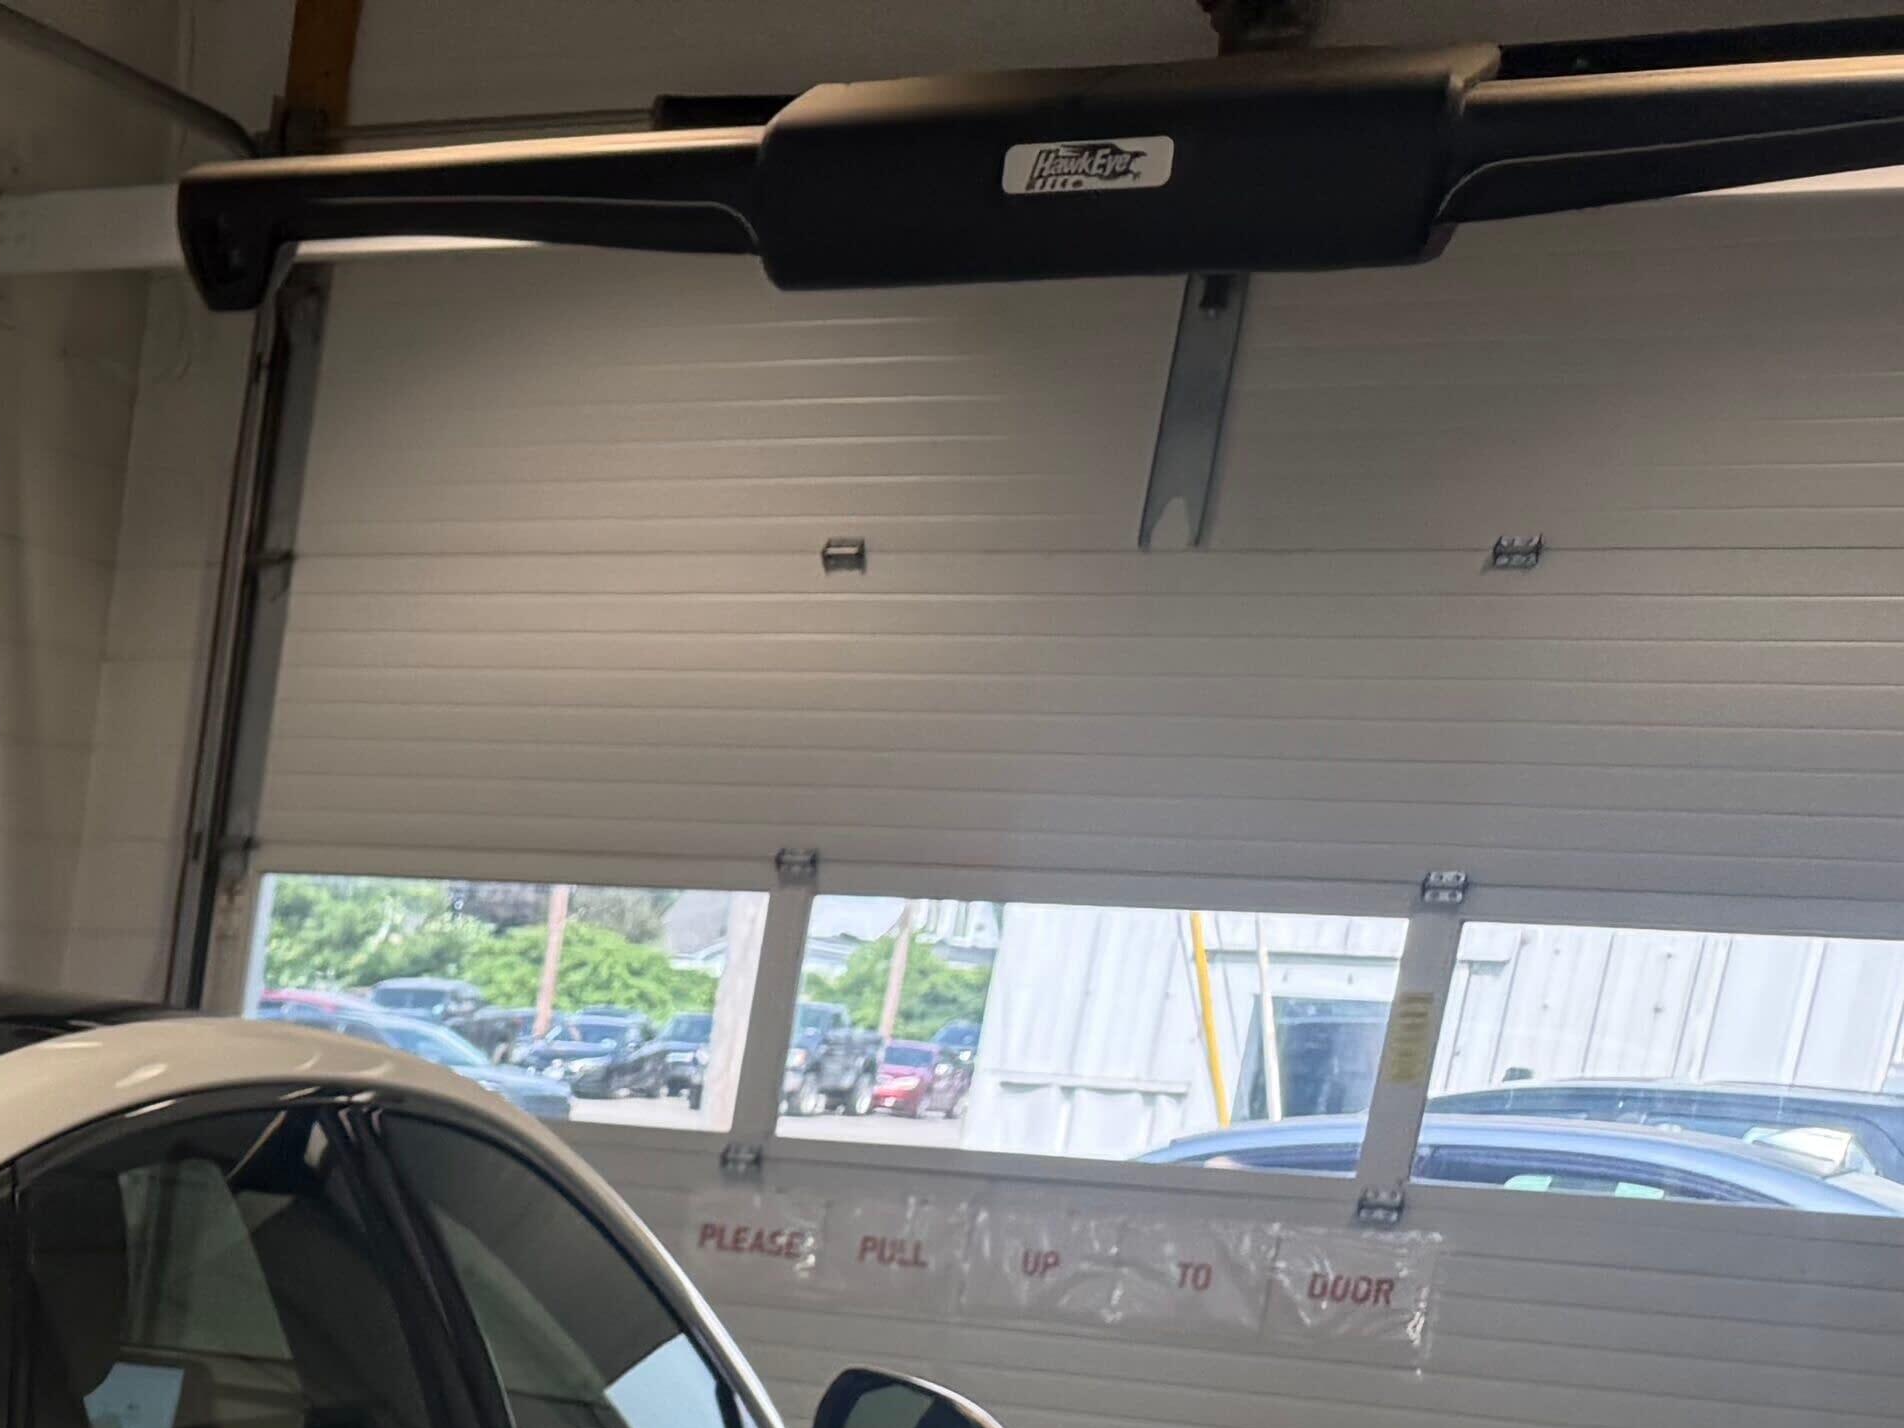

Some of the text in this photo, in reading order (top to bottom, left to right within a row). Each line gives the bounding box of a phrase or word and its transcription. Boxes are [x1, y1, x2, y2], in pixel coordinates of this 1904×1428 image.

[1033, 147, 1131, 177] HawkEye
[698, 1222, 1395, 1306] PLEASE PULL UP TO DOOR
